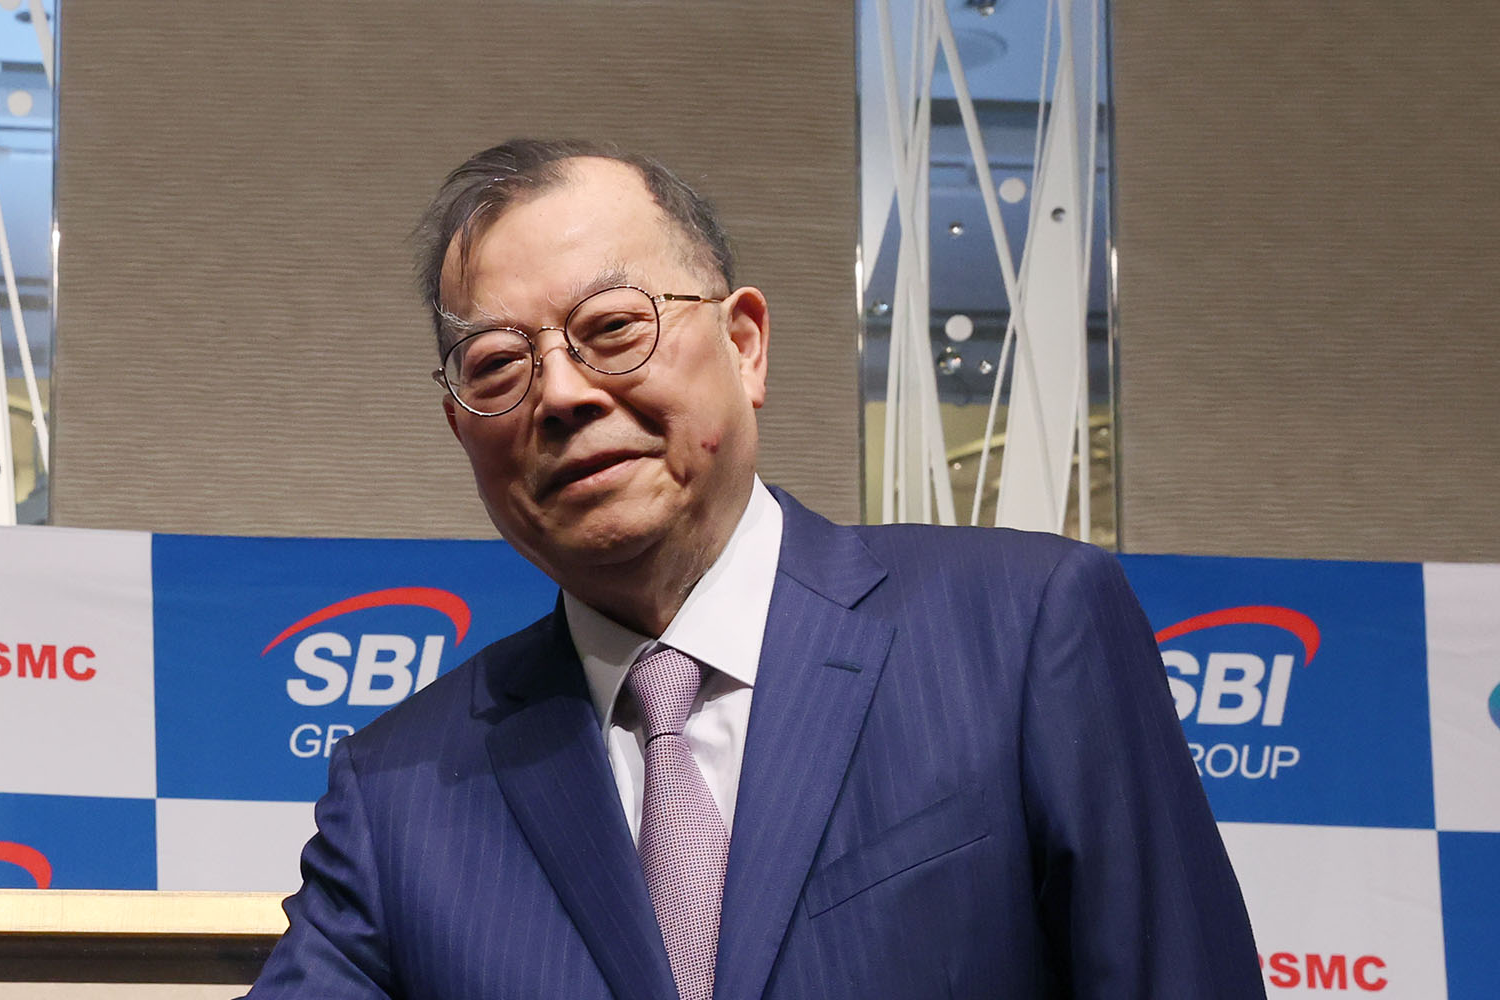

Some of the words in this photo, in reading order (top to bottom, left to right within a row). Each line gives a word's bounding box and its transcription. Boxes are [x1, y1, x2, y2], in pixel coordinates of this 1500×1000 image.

[286, 632, 445, 706] SBI
[1188, 743, 1300, 780] OUP
[1258, 952, 1388, 992] SMC
